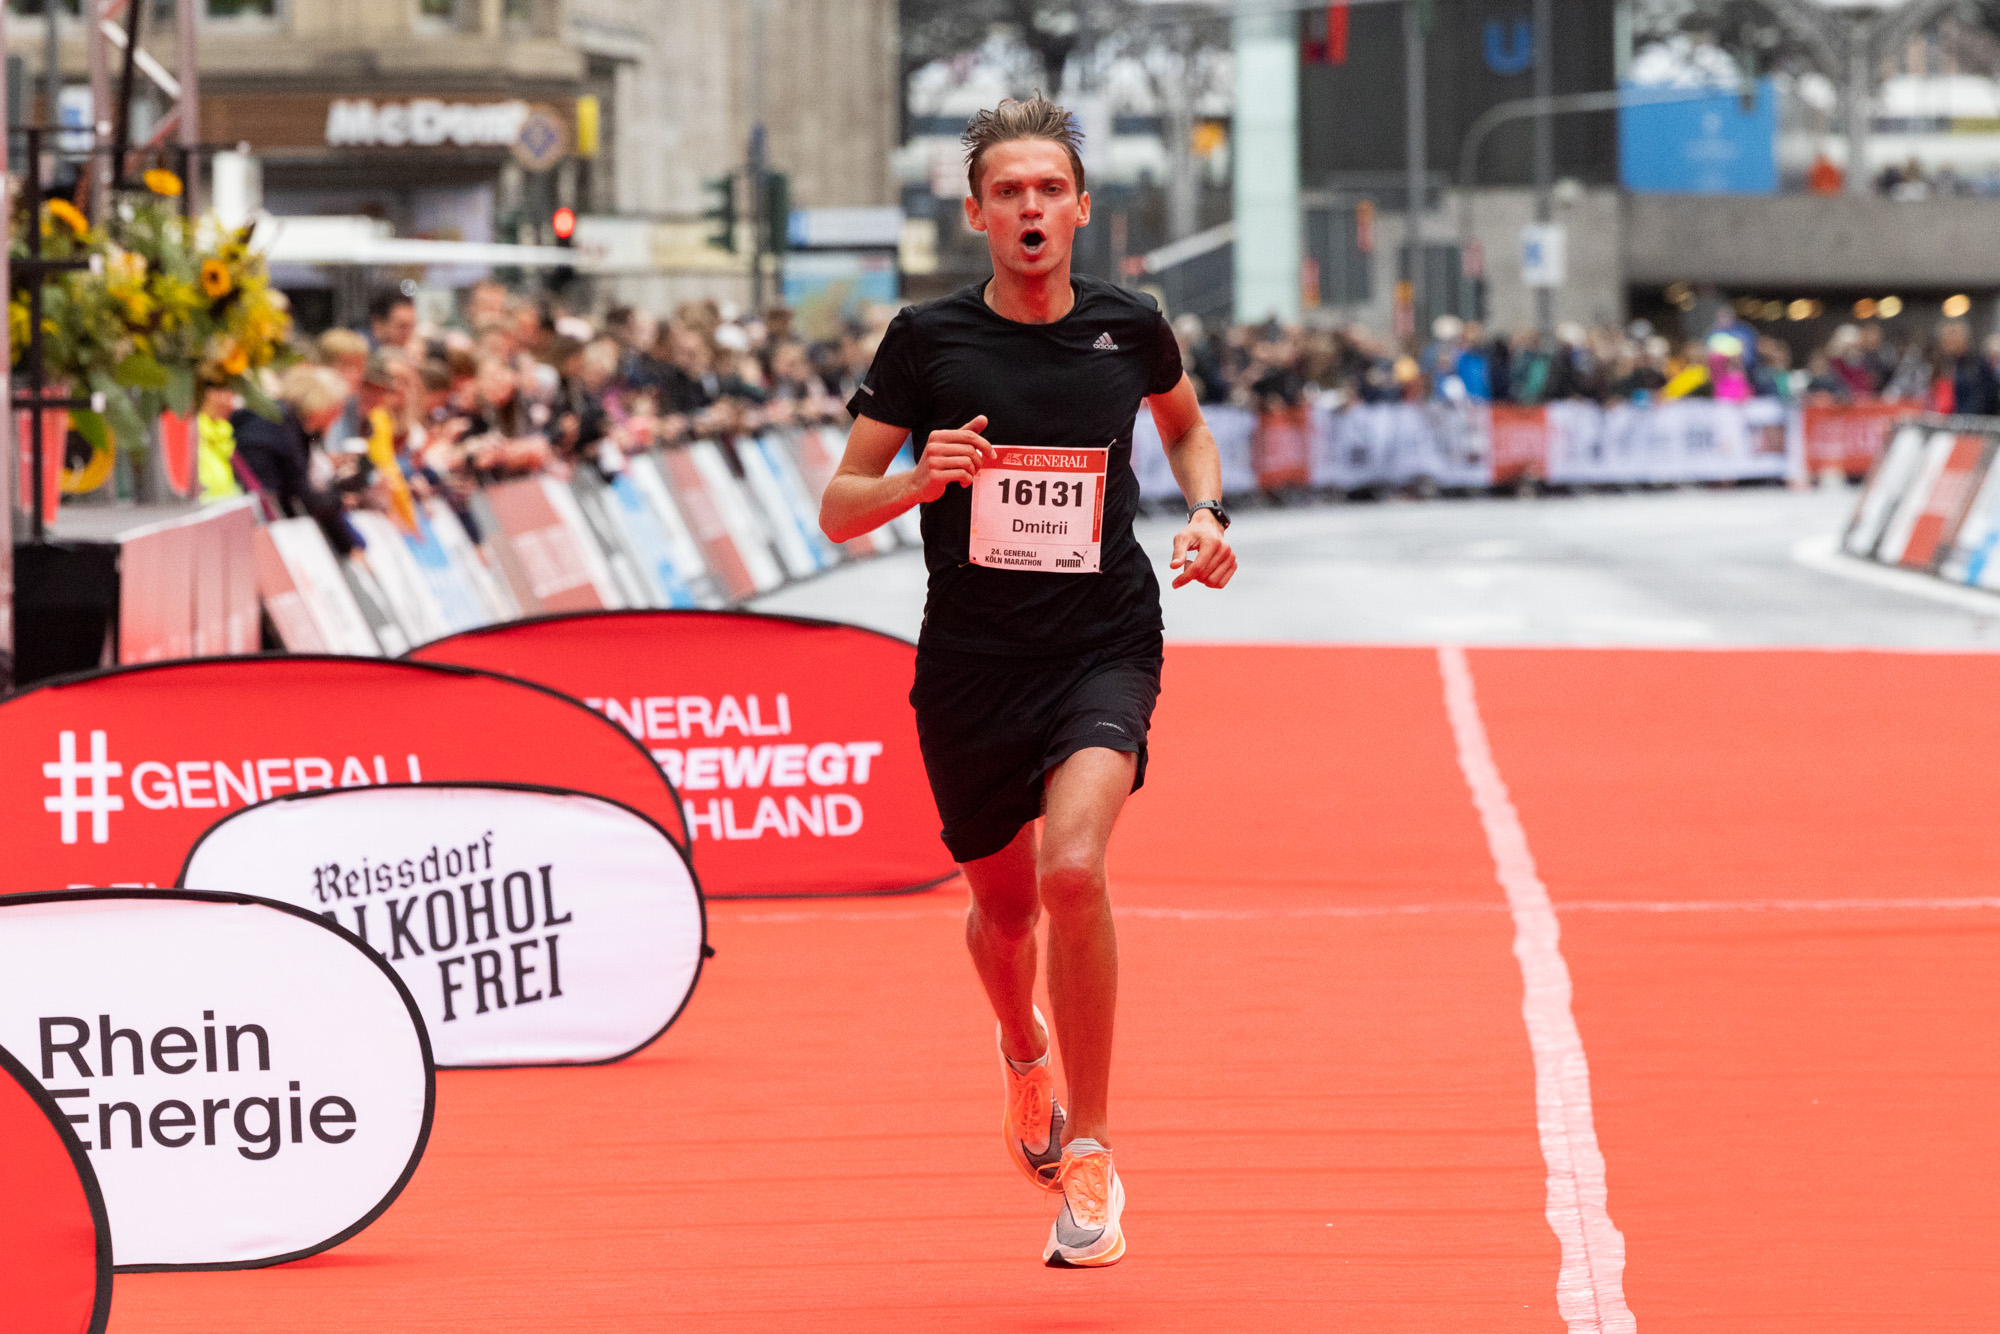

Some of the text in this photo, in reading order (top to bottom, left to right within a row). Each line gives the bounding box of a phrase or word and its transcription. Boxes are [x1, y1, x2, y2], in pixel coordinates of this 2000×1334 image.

[1483, 20, 1534, 75] U
[1093, 342, 1118, 350] adidas
[1023, 454, 1088, 468] GENERALI
[998, 478, 1083, 507] 16131
[1012, 519, 1068, 535] Dmitrii
[984, 555, 1042, 567] KÖLN MARATHON
[1003, 549, 1037, 558] GENERALI
[1055, 559, 1081, 568] PUMA
[312, 829, 495, 904] Reissdorf
[437, 933, 564, 1023] FREI
[38, 1009, 271, 1080] Rhein
